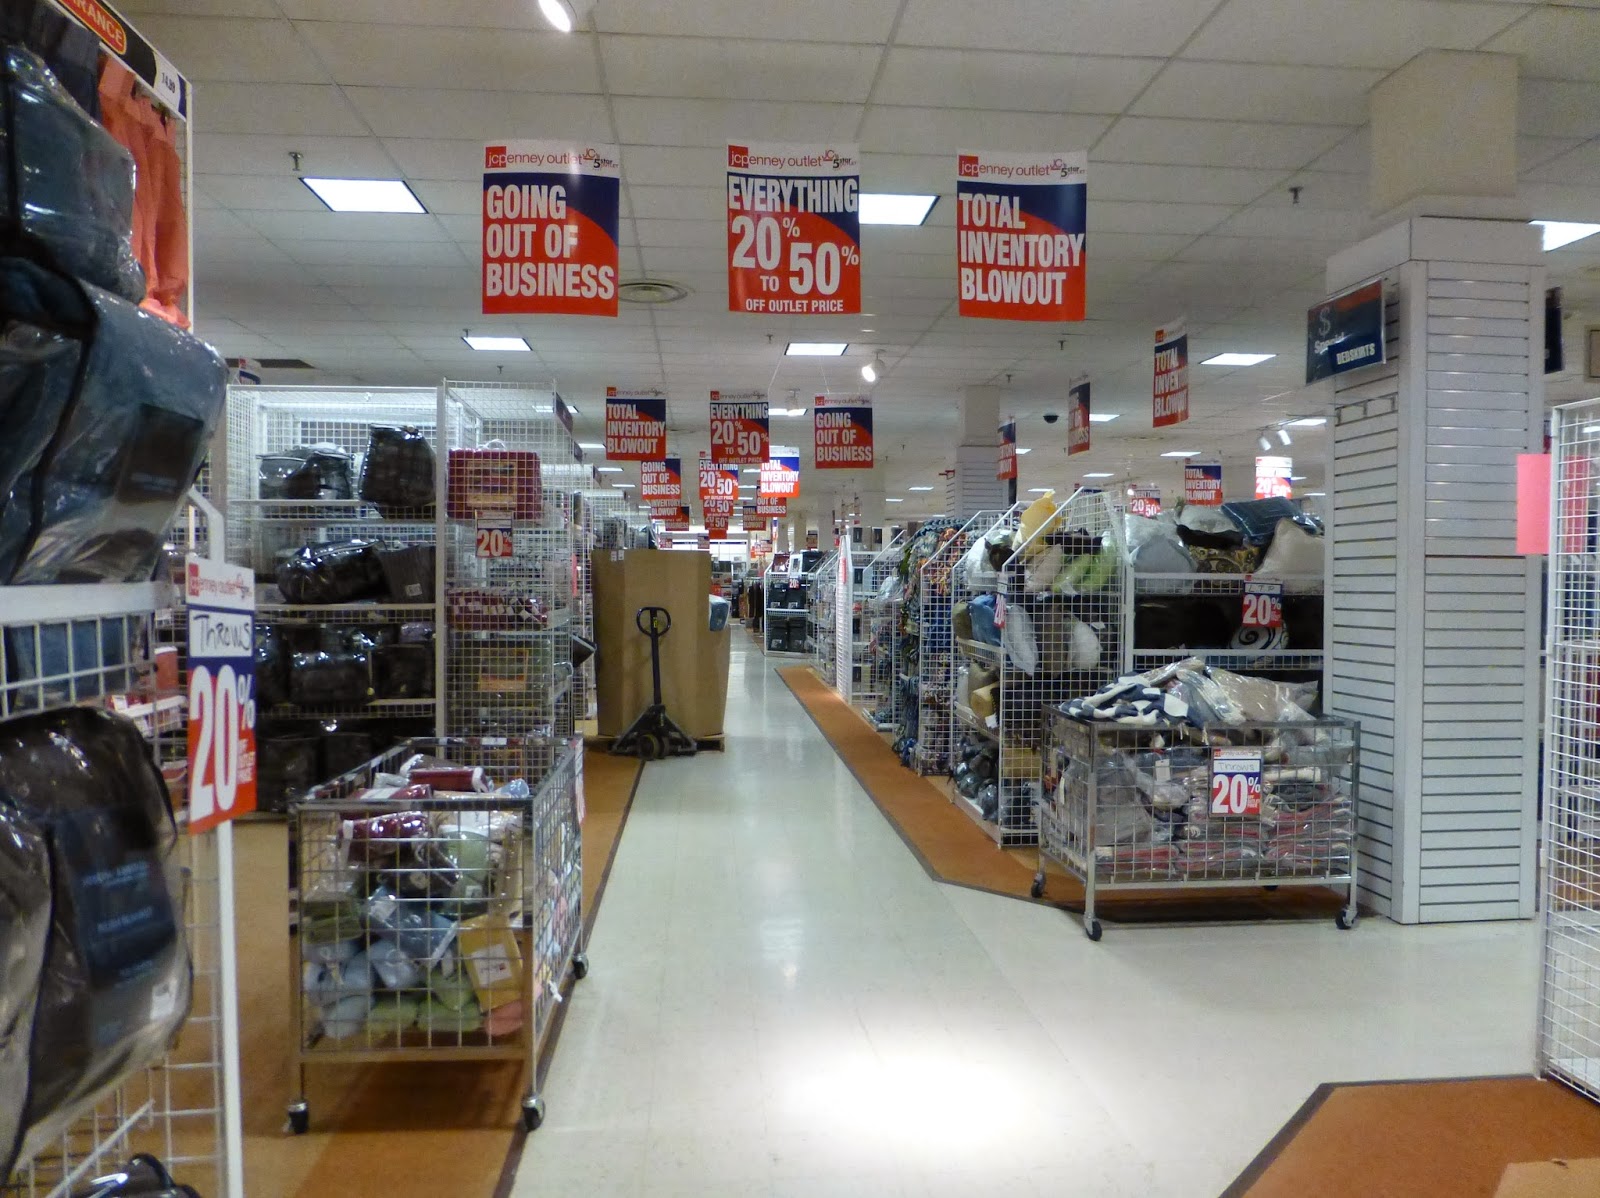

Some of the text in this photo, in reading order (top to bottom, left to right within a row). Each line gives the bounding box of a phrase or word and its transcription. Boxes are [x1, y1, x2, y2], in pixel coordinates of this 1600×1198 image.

[73, 0, 124, 47] RANCE
[488, 152, 583, 168] jcpenney outlet
[730, 151, 822, 169] jcpenney outlet
[960, 160, 1050, 178] jcpenney outlet
[486, 184, 566, 219] GOING
[728, 175, 858, 213] EVERYTHING
[958, 192, 1026, 229] TOTAL
[486, 224, 578, 258] OUT OF
[960, 230, 1085, 267] INVENTORY
[486, 262, 615, 299] BUSINESS
[760, 275, 779, 292] TO
[960, 267, 1066, 305] BLOWOUT
[745, 298, 844, 312] OFF OUTLET PRICE
[607, 404, 639, 419] TOTAL
[711, 403, 769, 420] EVERYTHING
[816, 412, 851, 428] GOING
[607, 421, 666, 437] INVENTORY
[816, 429, 857, 445] OUT OF
[607, 437, 658, 454] BLOWOUT
[725, 446, 734, 455] TO
[816, 446, 872, 462] BUSINESS
[642, 461, 666, 472] GOING
[1185, 468, 1204, 479] TOTAL
[642, 473, 670, 484] OUT OF
[761, 470, 799, 482] INVENTORY
[642, 484, 680, 495] BUSINESS
[761, 482, 794, 493] BLOWOUT
[1185, 479, 1220, 490] INVENTORY
[757, 497, 778, 505] OUT OF
[1185, 490, 1216, 500] BLOWOUT
[757, 506, 786, 514] BUSINESS
[1242, 594, 1281, 625] 20%
[190, 664, 256, 823] 20%
[1211, 773, 1260, 814] 20%
